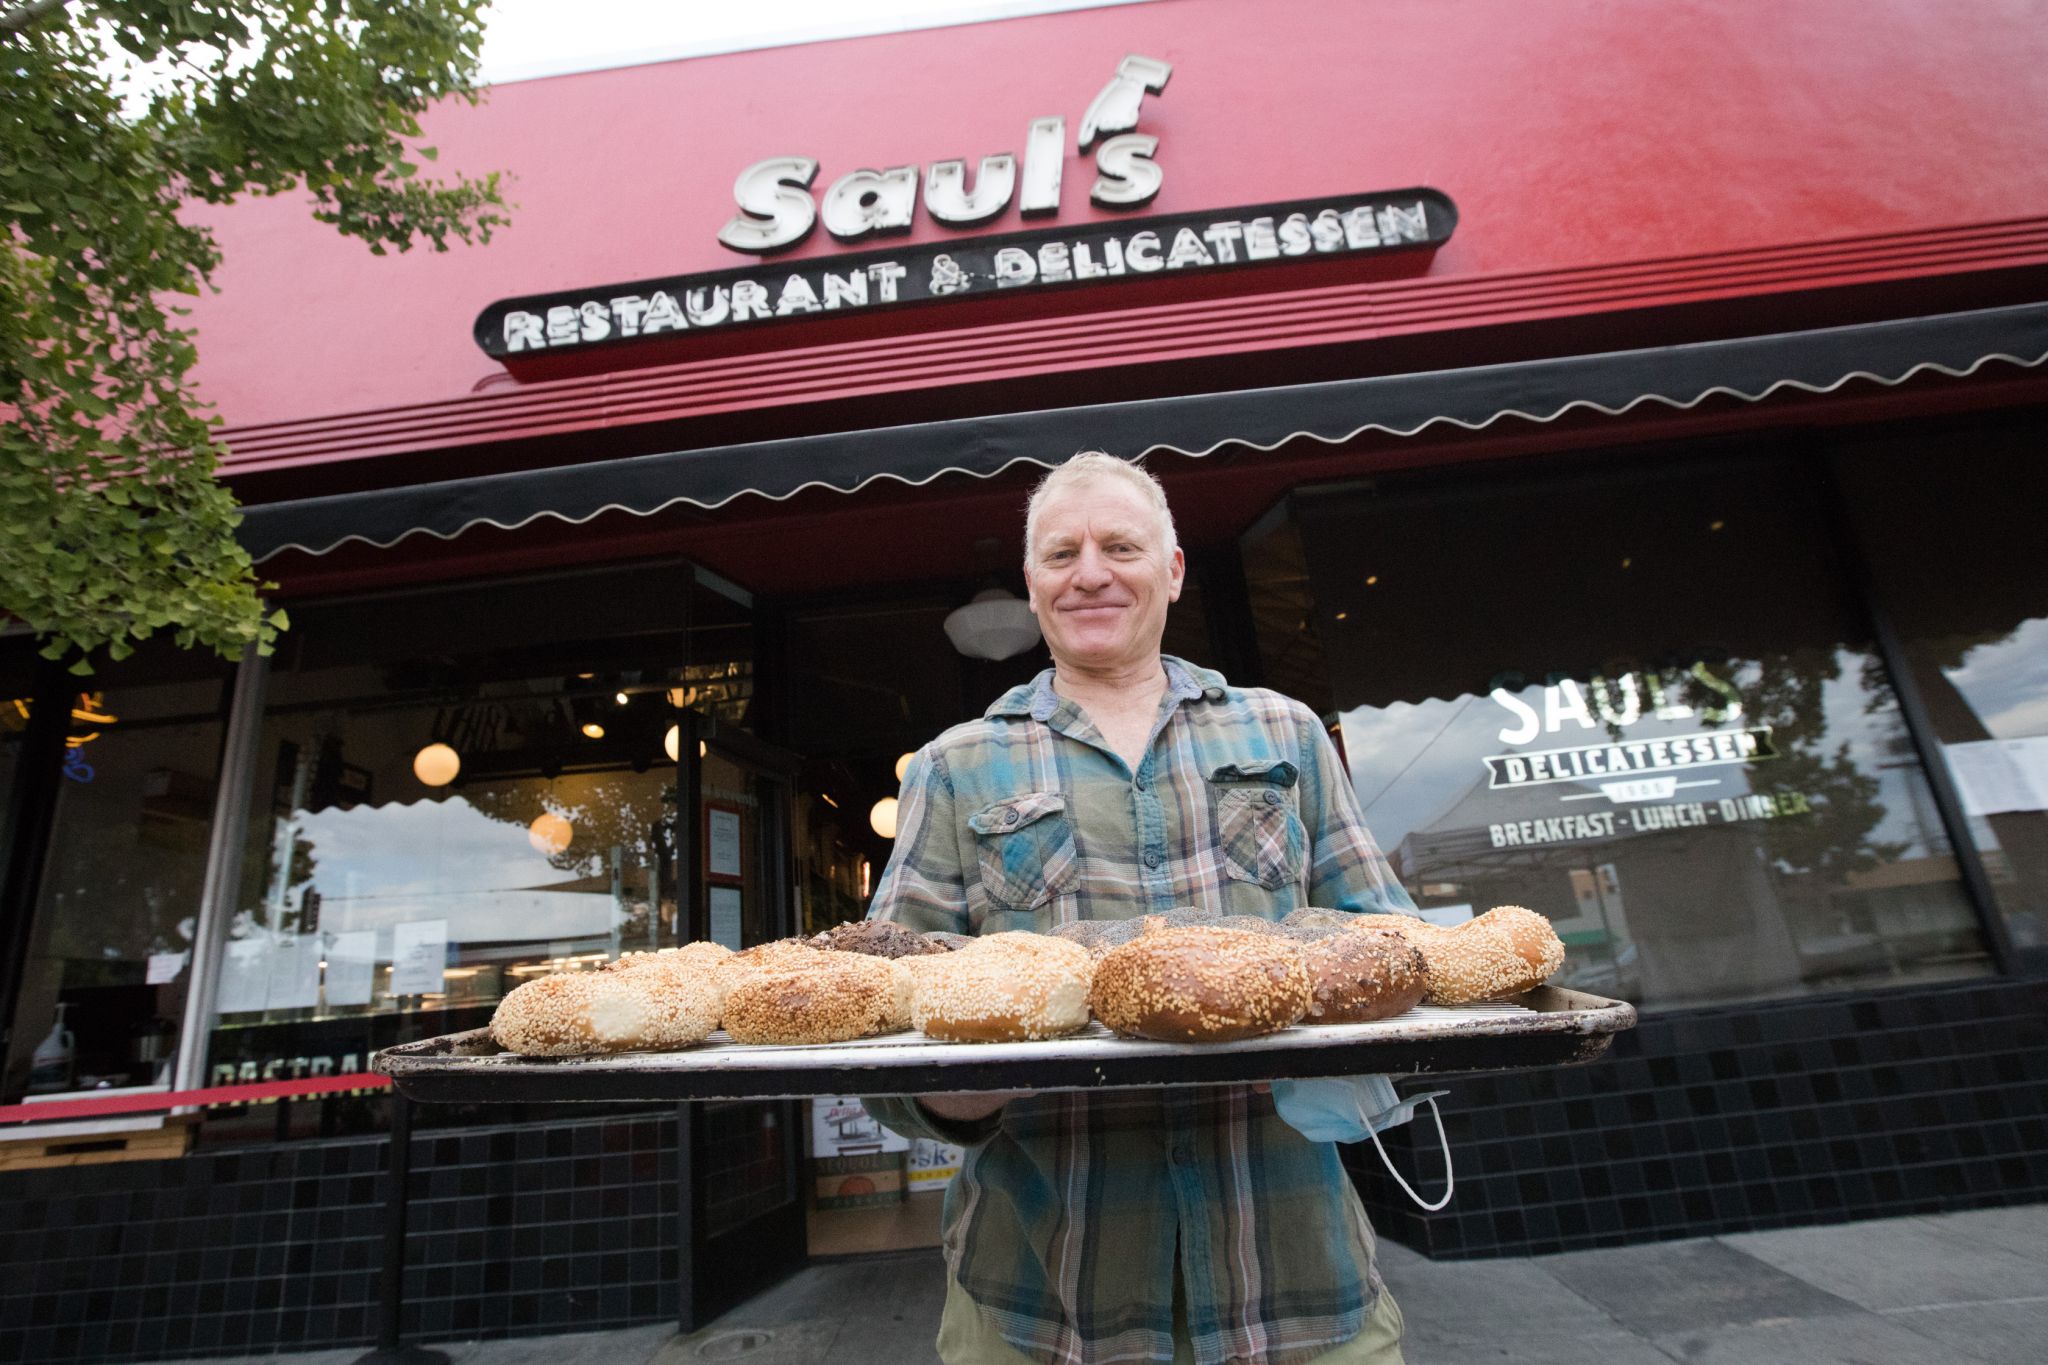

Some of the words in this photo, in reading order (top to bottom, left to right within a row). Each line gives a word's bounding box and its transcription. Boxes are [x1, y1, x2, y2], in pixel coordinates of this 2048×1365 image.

[503, 262, 907, 352] RESTAURANT
[929, 254, 971, 296] &
[994, 201, 1429, 289] DELICATESSEN
[1506, 733, 1758, 783] DELICATESSEN
[1489, 812, 1615, 848] BREAKFAST
[1630, 803, 1708, 832] LUNCH
